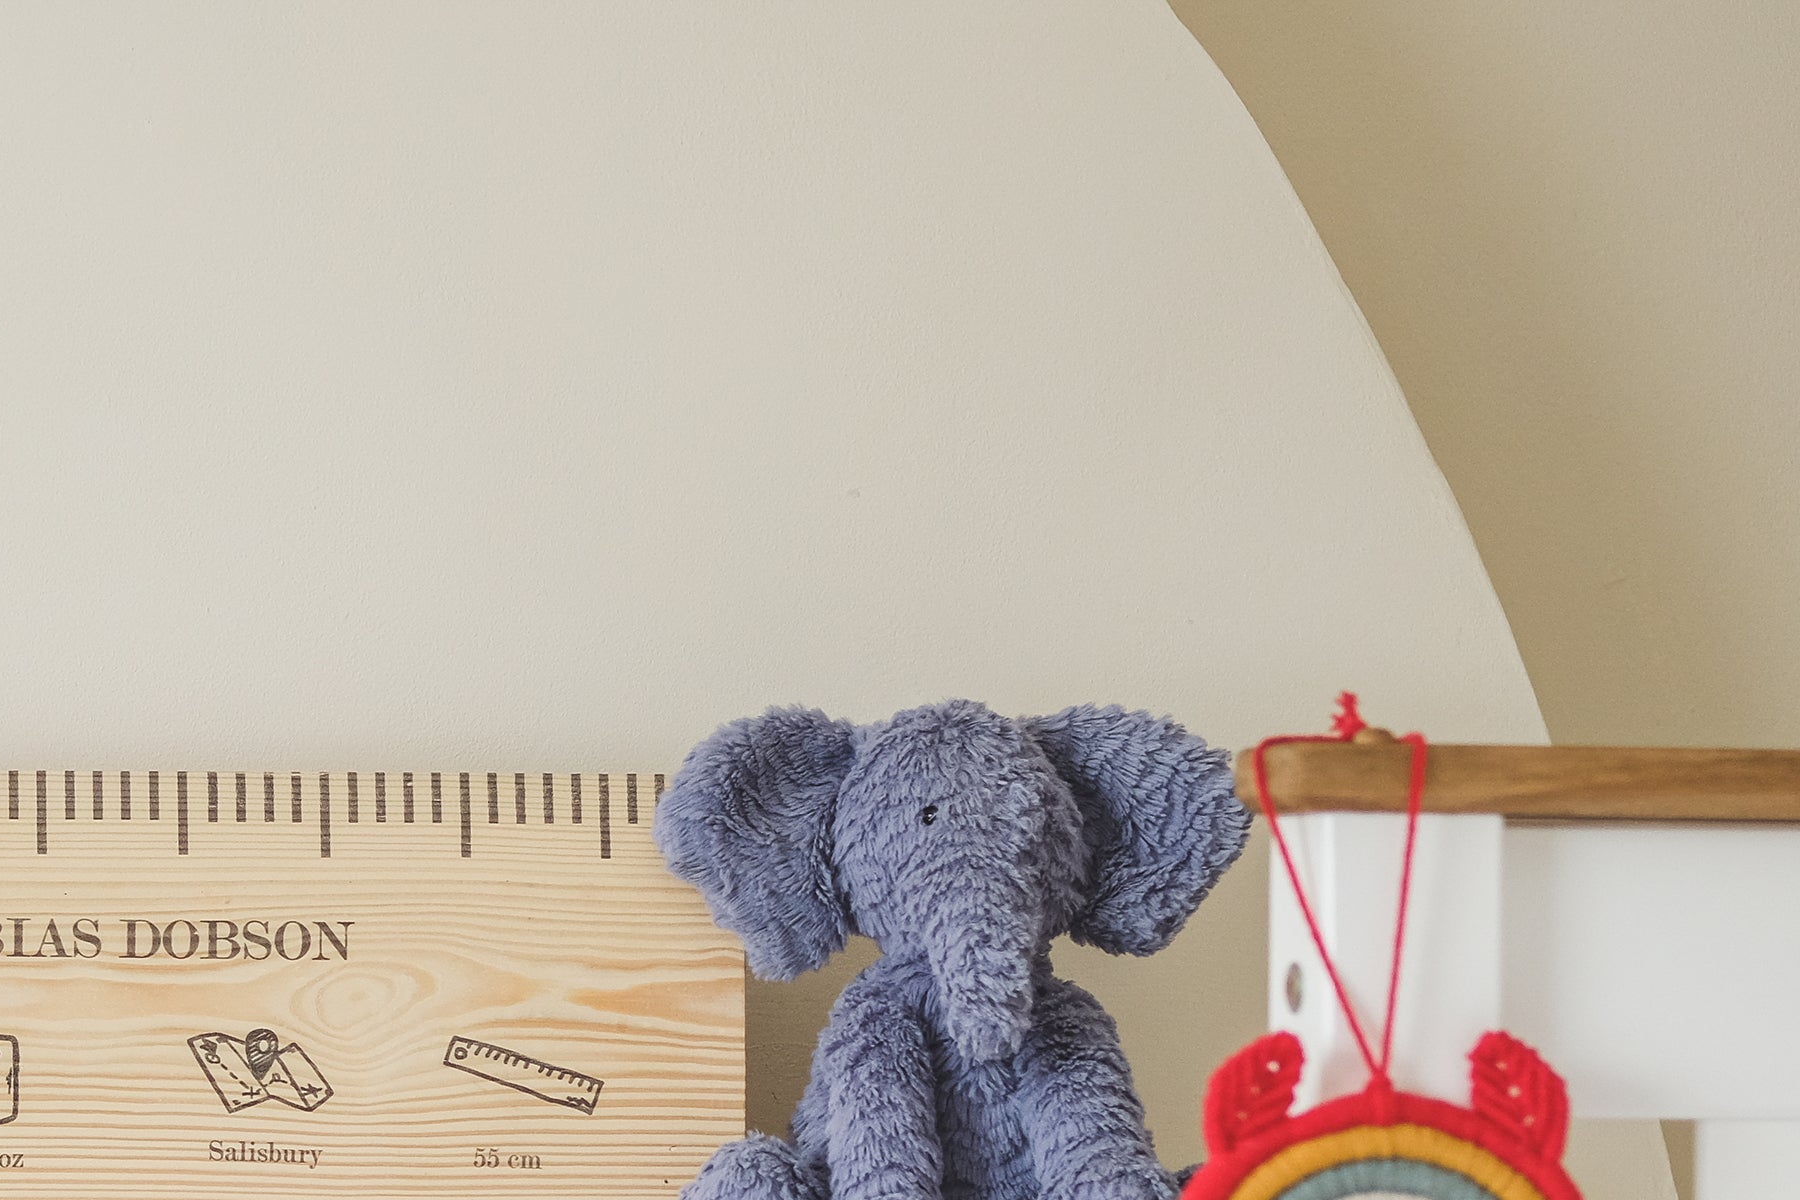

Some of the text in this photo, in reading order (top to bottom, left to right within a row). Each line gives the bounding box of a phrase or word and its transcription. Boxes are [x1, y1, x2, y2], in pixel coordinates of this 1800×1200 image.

[118, 918, 356, 961] DOBSON
[208, 1139, 323, 1170] Salisbury
[472, 1146, 543, 1170] 55 cm
